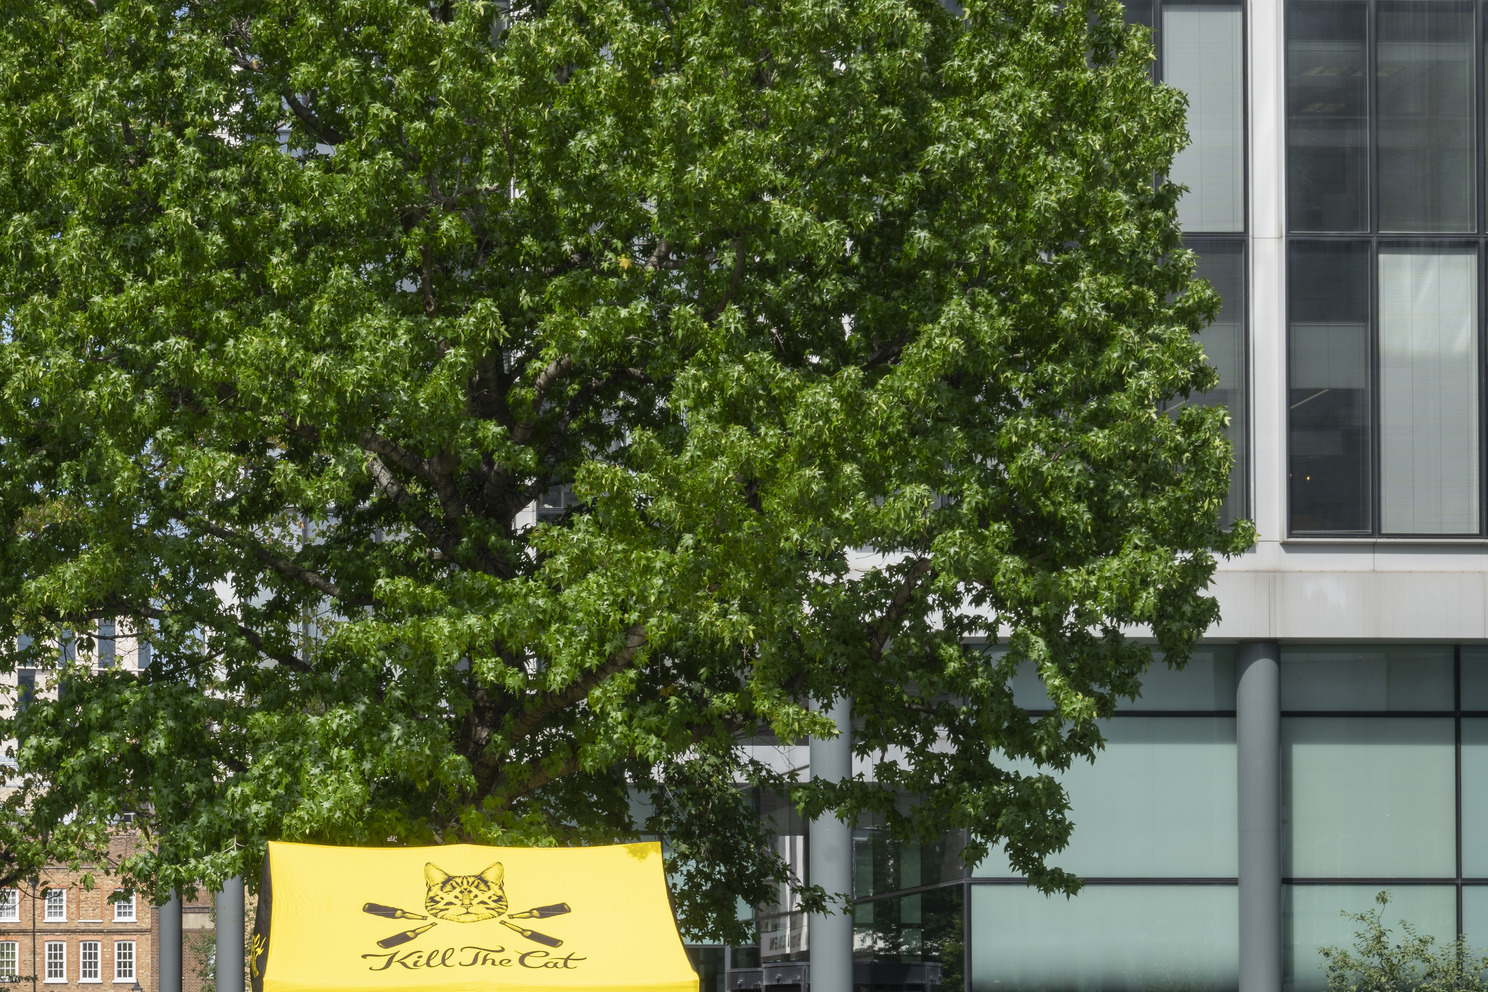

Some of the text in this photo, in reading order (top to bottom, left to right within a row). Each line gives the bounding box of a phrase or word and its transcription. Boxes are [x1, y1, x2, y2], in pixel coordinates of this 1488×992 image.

[361, 945, 588, 971] Kill The Cat
